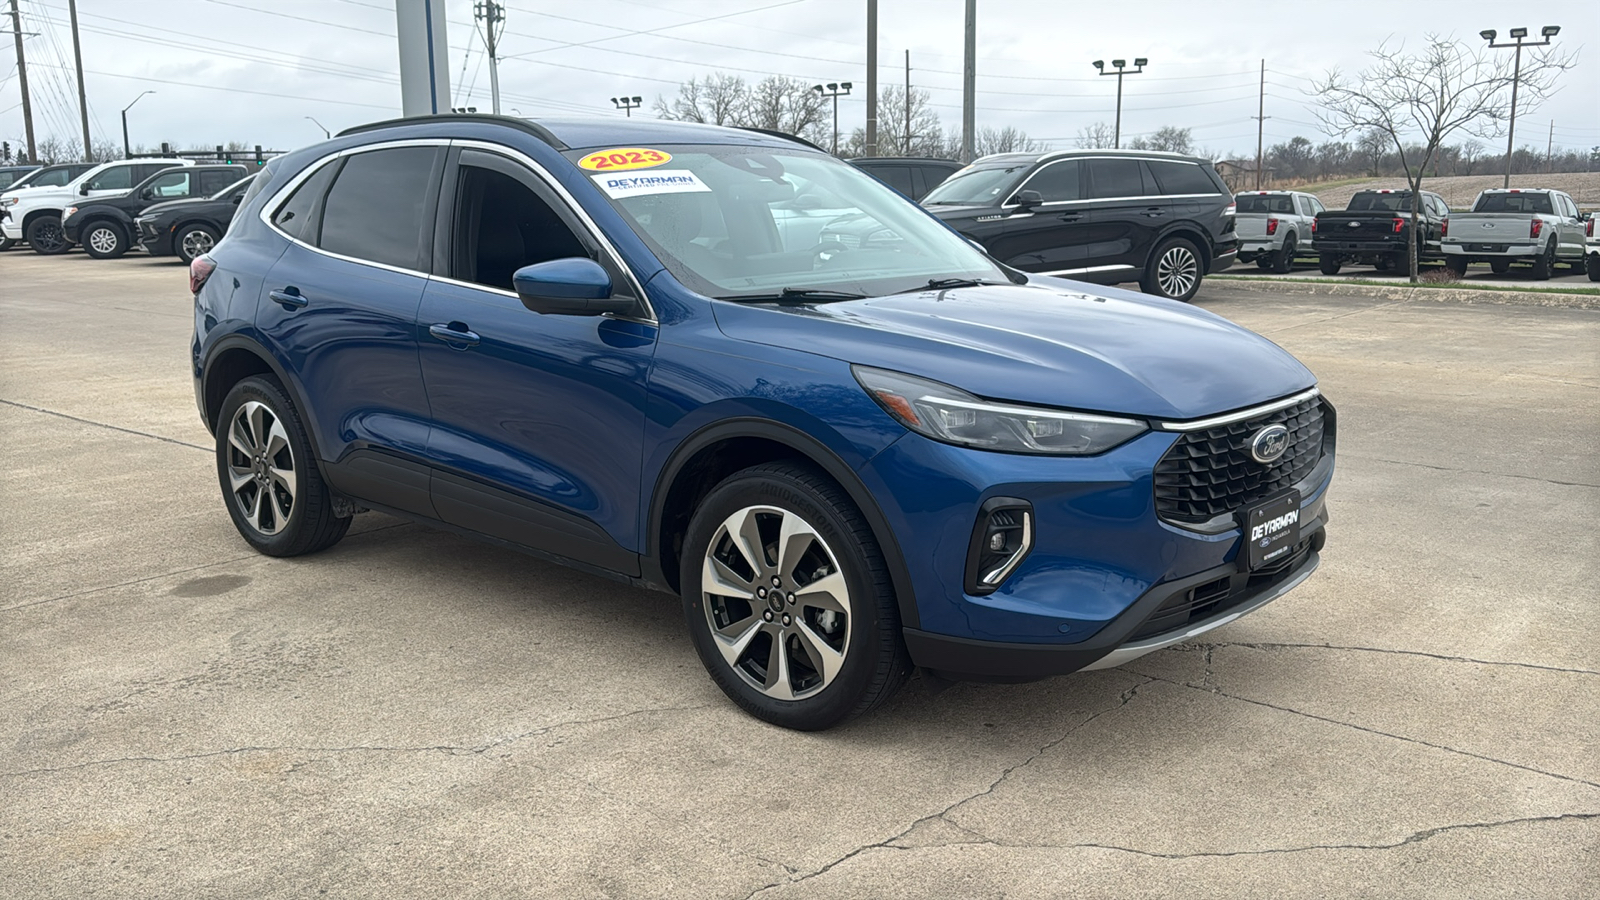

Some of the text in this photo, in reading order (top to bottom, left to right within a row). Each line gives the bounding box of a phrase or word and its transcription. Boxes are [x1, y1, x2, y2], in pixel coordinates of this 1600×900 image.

[590, 150, 664, 169] 2023
[606, 176, 694, 188] DEYARMAN
[1263, 432, 1285, 456] Ford
[1251, 508, 1299, 542] DEYARMAN
